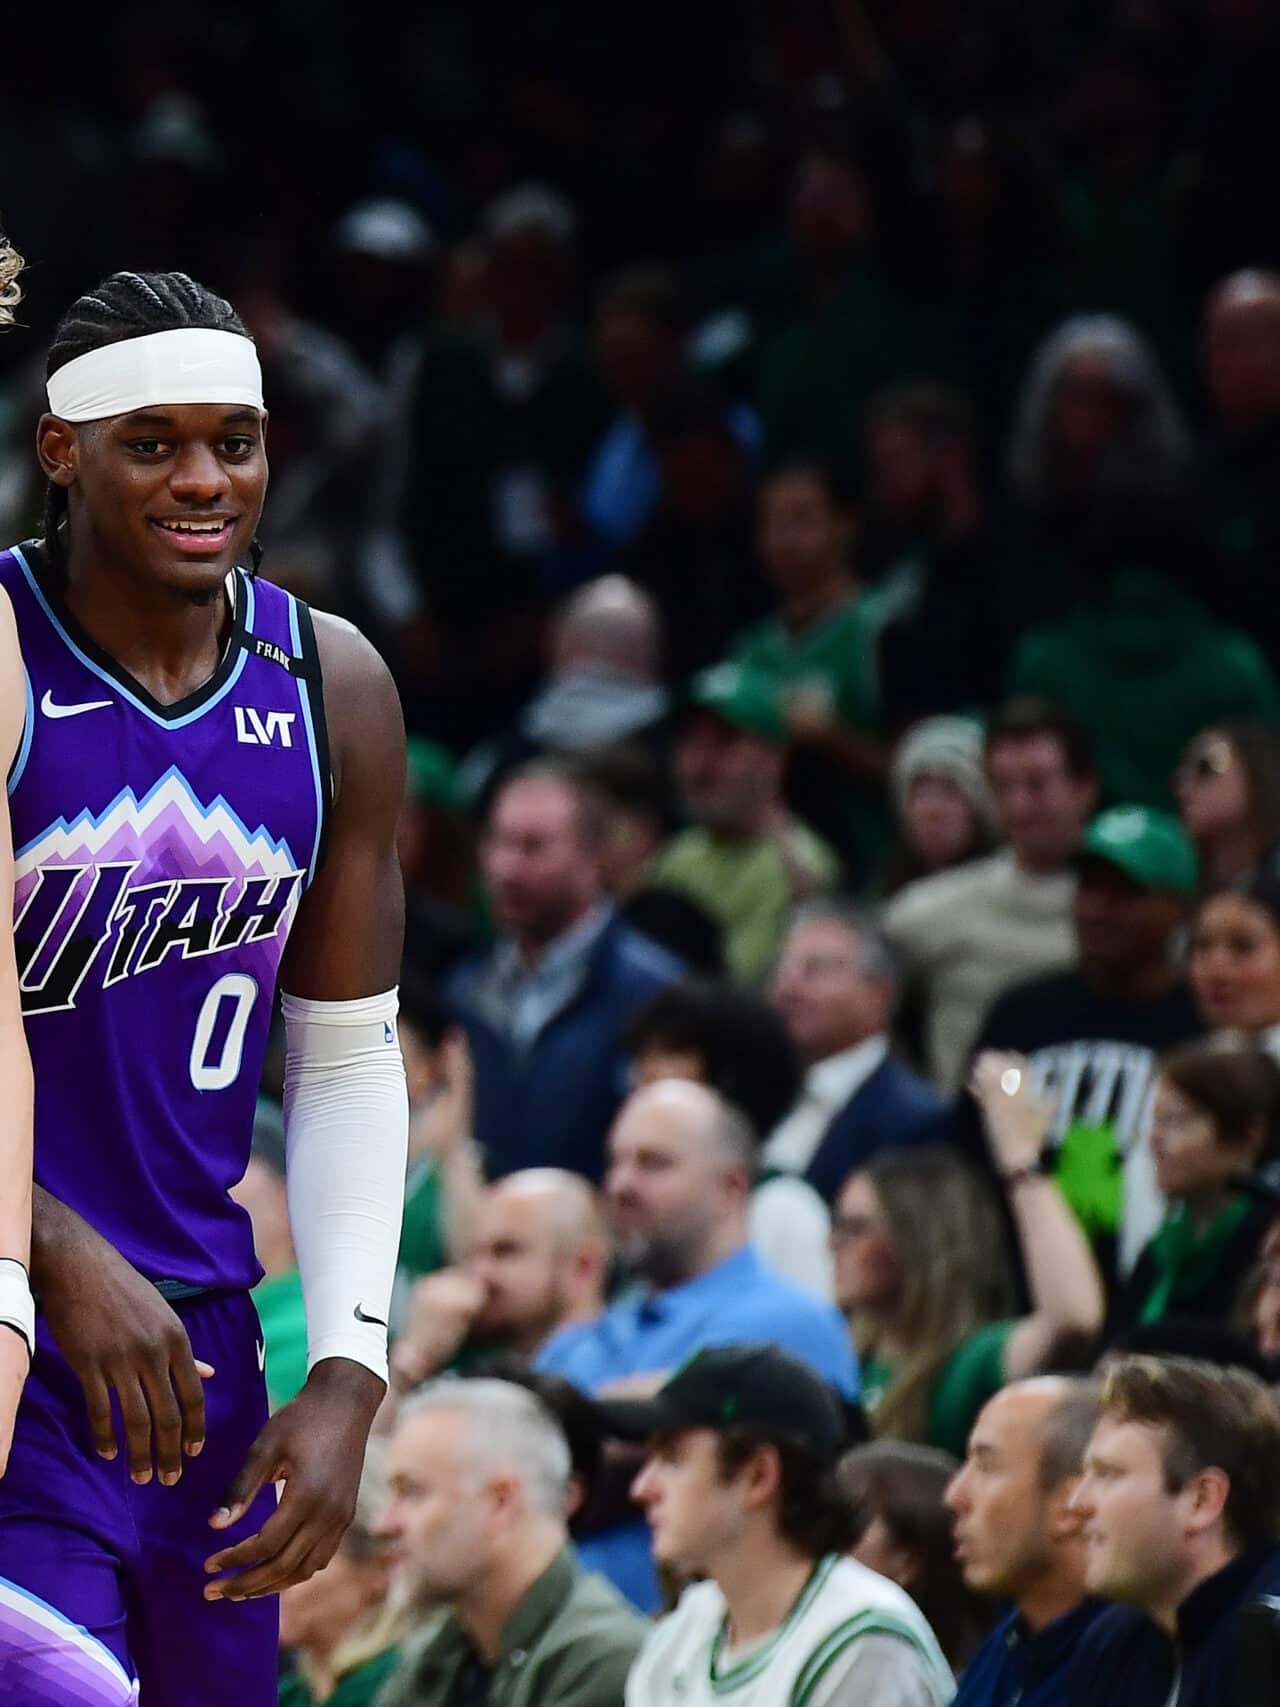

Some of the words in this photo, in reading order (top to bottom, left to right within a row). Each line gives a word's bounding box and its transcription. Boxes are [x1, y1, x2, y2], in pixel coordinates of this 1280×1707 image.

[256, 641, 290, 671] FRANK
[234, 706, 296, 747] LVT
[13, 860, 307, 1016] UTAH
[189, 973, 258, 1090] 0
